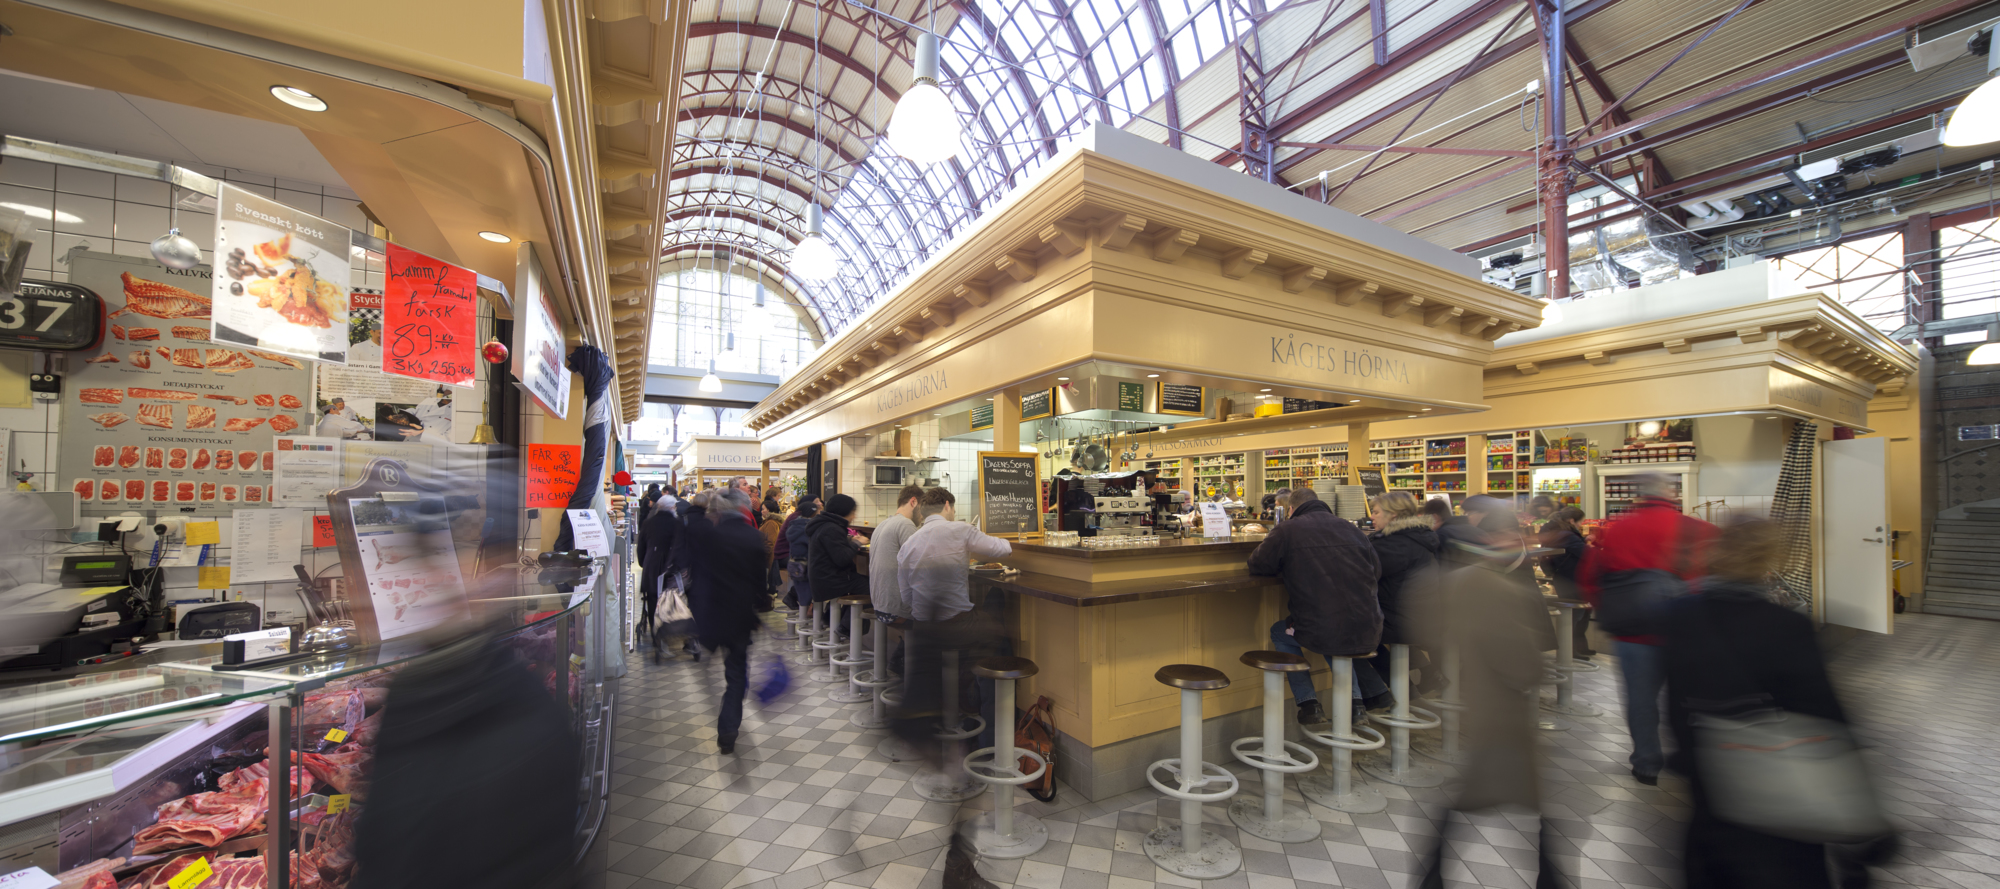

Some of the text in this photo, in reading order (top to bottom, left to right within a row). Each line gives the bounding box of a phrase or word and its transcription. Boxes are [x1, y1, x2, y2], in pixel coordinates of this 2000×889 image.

[235, 203, 324, 240] Svenskt kött
[388, 256, 435, 281] Lamm
[21, 287, 72, 298] ETJÄNAS
[354, 295, 383, 306] Styck
[0, 298, 73, 332] 37
[1271, 333, 1410, 384] KÅGES HÖRNA
[163, 380, 225, 390] DETALJSTYCKAT
[877, 369, 948, 413] KÅGES HÖRNA
[147, 436, 233, 445] KONSUMENTSTYCKAT
[532, 448, 552, 461] FÅR
[709, 455, 741, 463] HUGO
[530, 464, 549, 473] HEL
[1010, 459, 1031, 469] SOPPA
[177, 866, 207, 889] Lammlägg
